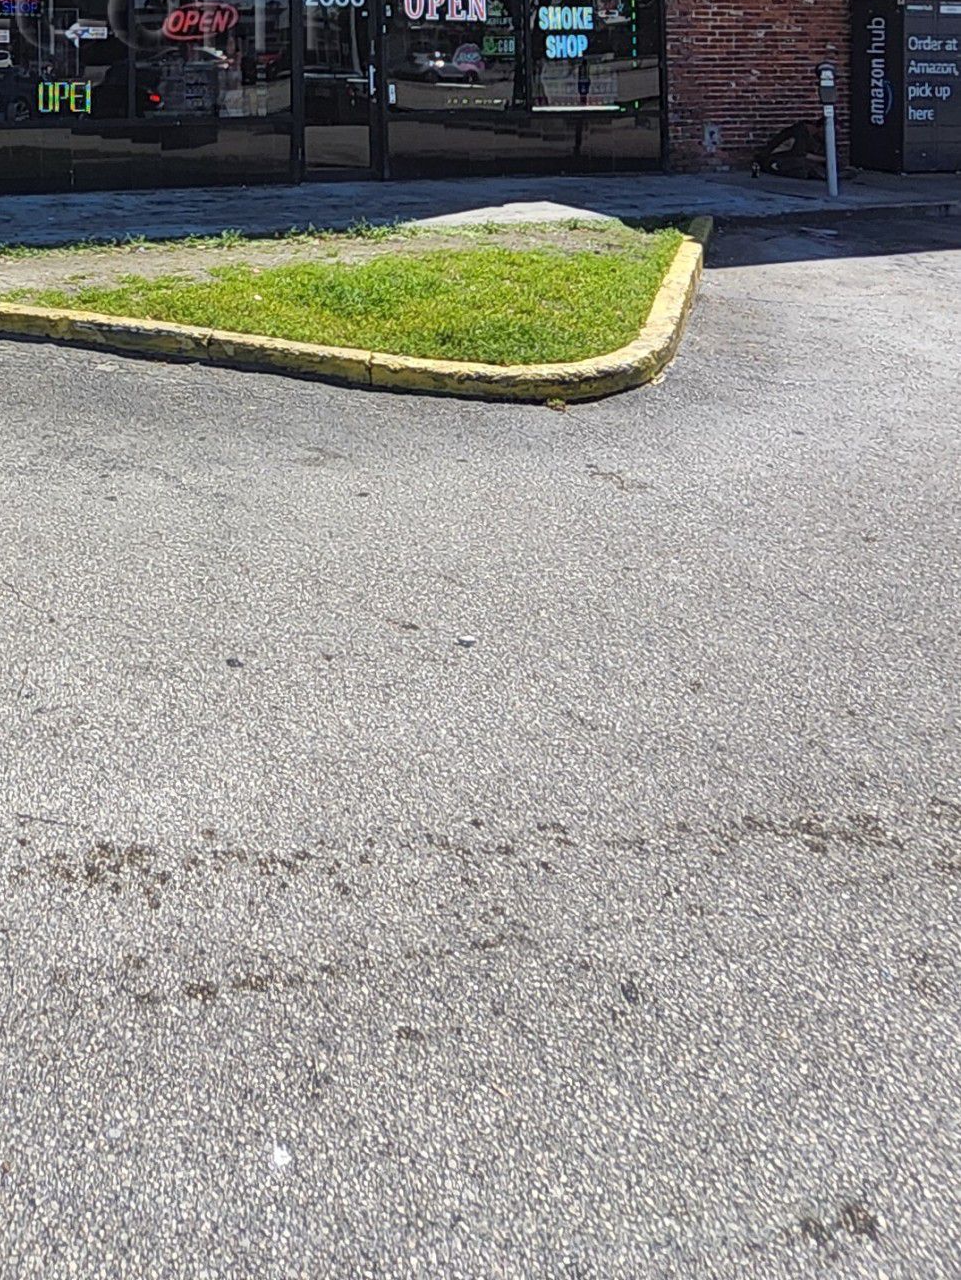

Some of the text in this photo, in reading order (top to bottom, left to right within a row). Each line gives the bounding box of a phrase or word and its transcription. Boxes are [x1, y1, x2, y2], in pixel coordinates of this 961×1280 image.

[169, 11, 229, 33] OPEN
[538, 5, 594, 30] SMOKE
[545, 34, 588, 59] SHOP
[907, 36, 958, 51] Order at
[866, 17, 886, 125] amazon hub
[907, 60, 959, 76] Amazon,
[907, 83, 951, 100] pick up
[907, 106, 935, 120] here
